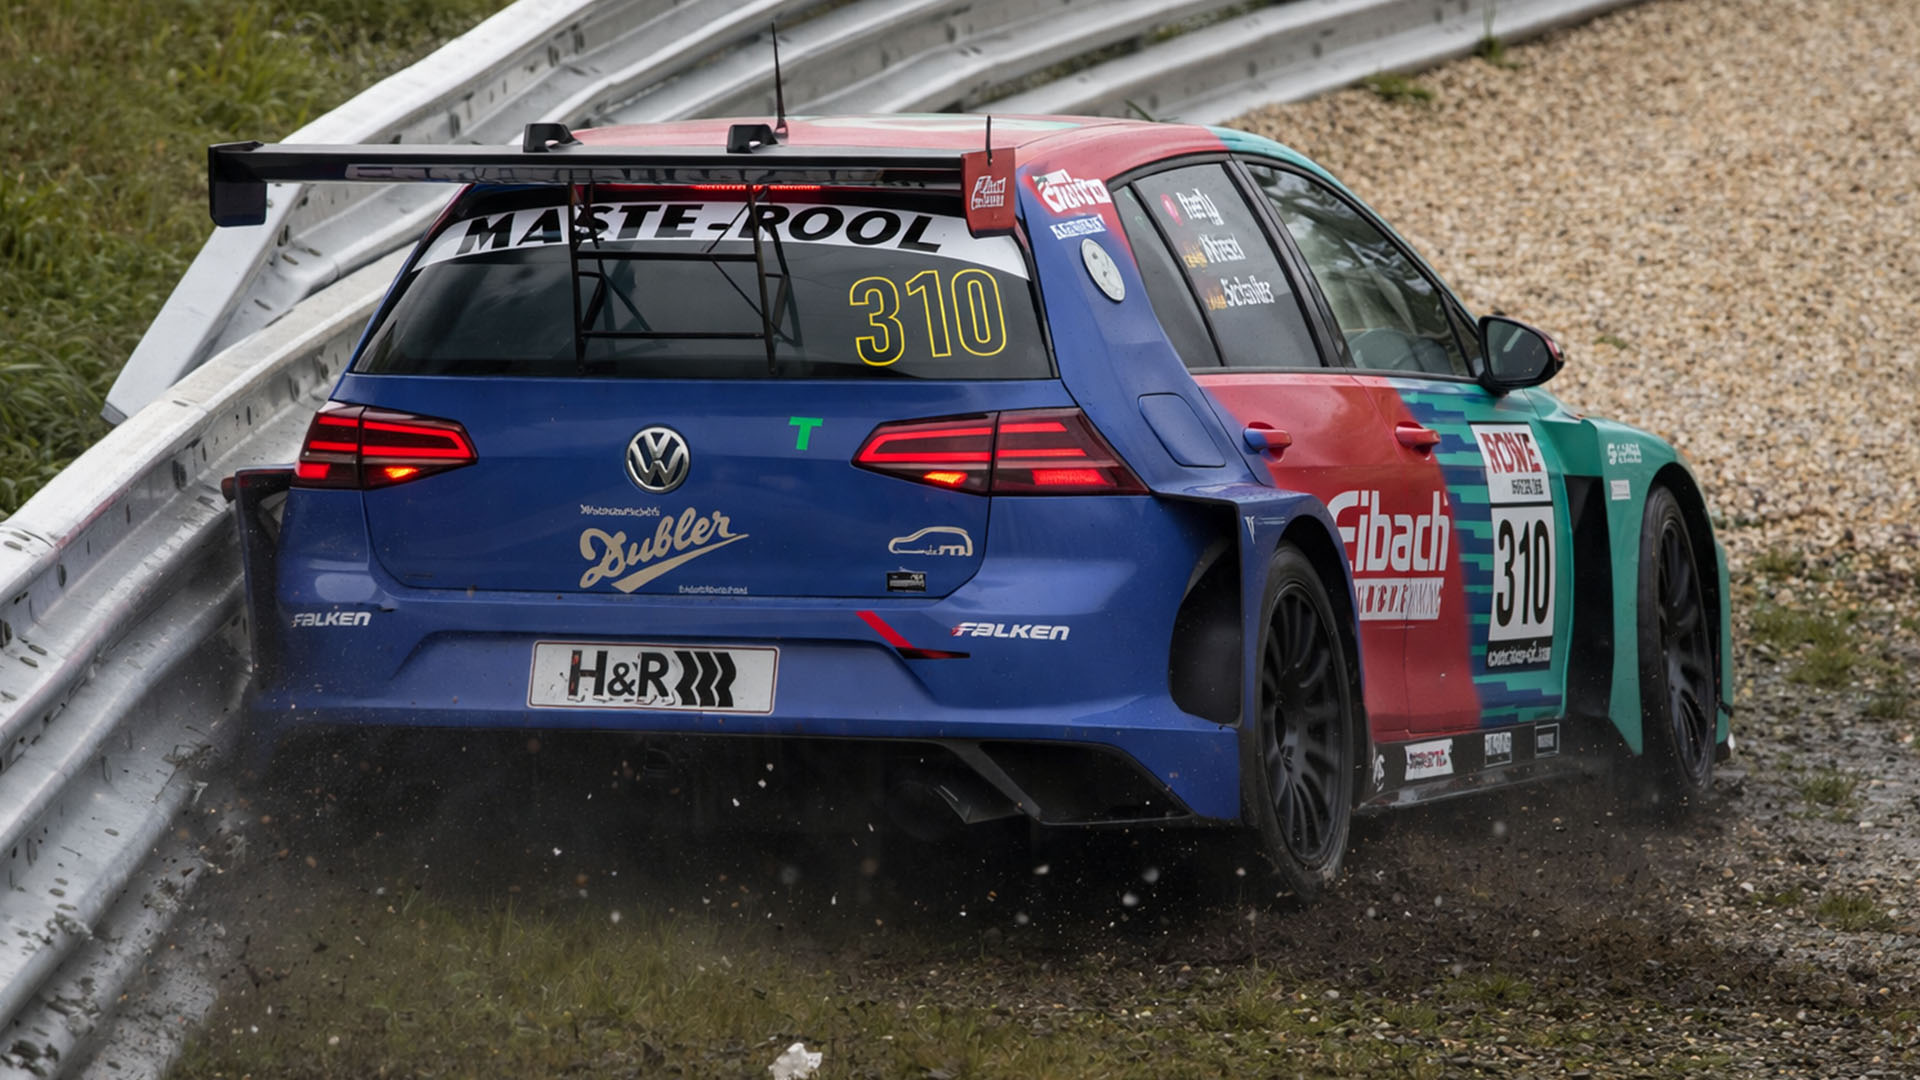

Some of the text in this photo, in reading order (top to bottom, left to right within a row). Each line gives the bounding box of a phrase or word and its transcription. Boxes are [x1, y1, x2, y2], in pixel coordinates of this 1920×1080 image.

[849, 268, 1007, 367] 310
[789, 416, 823, 451] T
[1480, 432, 1542, 474] ROWE
[1326, 490, 1450, 572] Eibach
[1497, 519, 1551, 627] 310
[292, 611, 373, 628] FALKEN
[951, 622, 1071, 641] FALKEN
[567, 650, 674, 704] H&R
